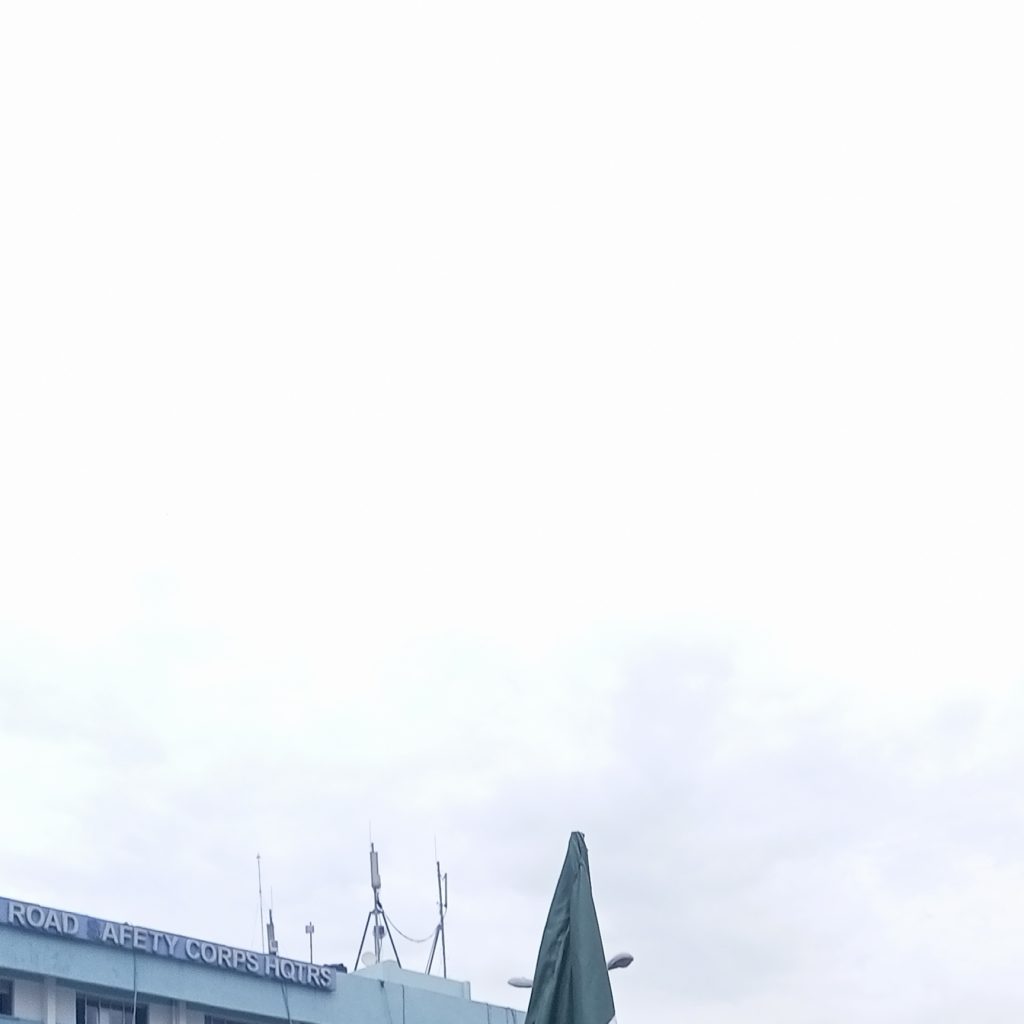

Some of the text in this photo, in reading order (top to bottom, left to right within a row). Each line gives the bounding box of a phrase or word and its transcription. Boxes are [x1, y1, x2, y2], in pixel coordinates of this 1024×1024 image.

[7, 901, 79, 935] ROAD
[185, 938, 259, 972] CORPS
[265, 955, 332, 987] HQTRS
